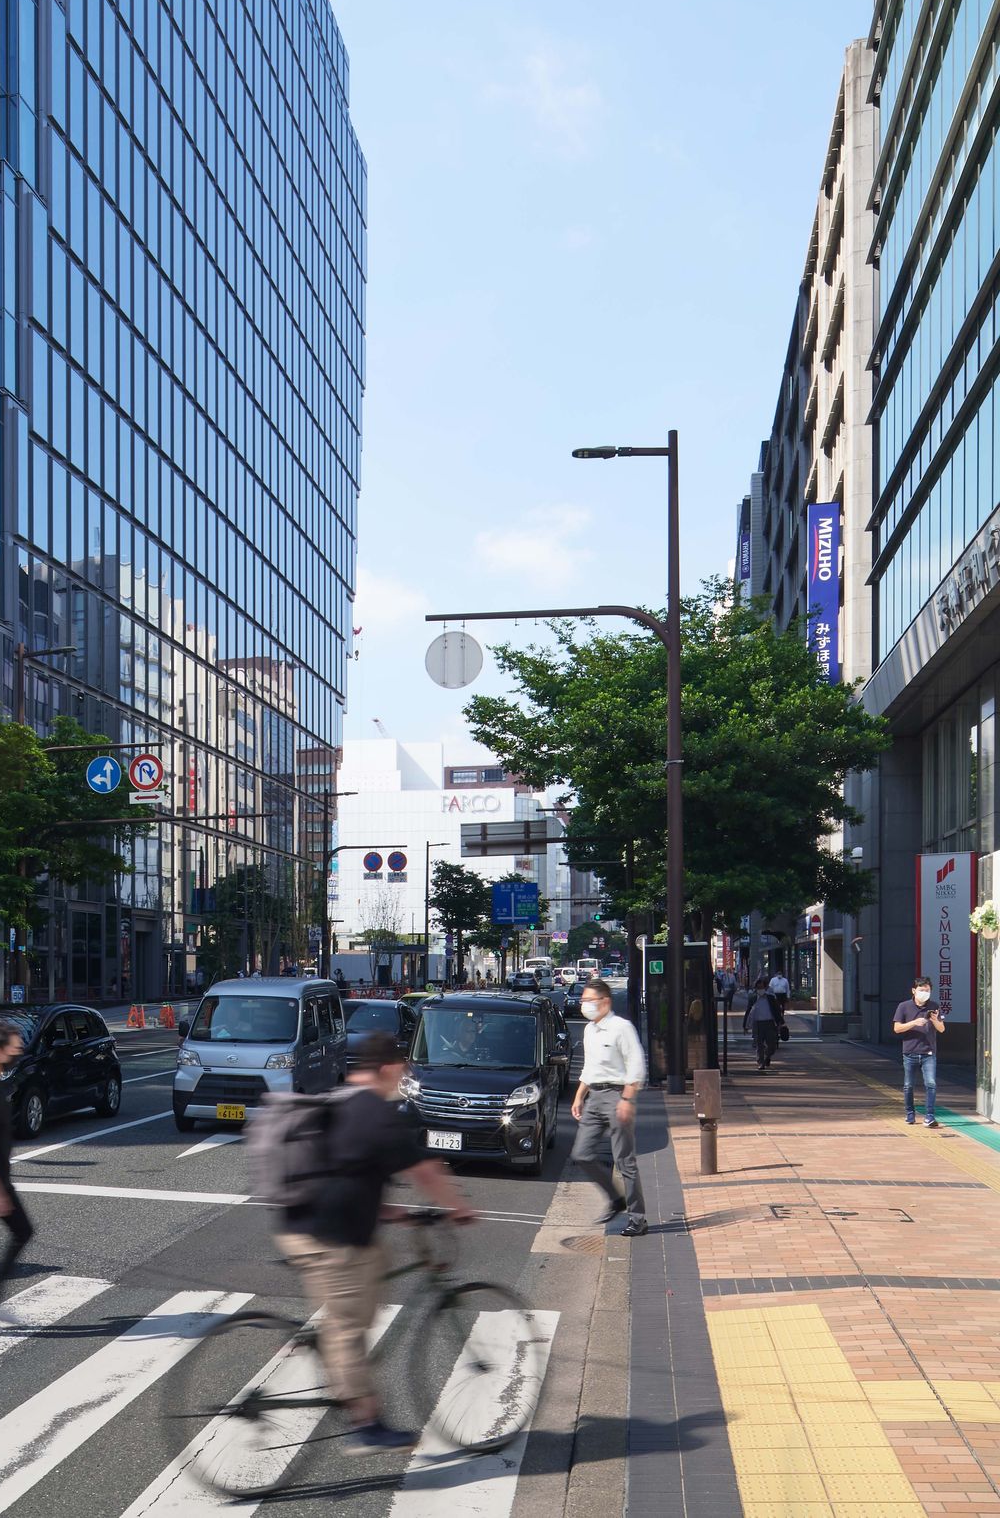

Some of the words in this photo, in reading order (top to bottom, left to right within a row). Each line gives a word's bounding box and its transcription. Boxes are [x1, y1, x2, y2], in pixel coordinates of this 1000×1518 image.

[818, 517, 833, 582] MIZUHO
[441, 794, 501, 813] PARCO
[938, 906, 952, 1015] SMBC日興証券
